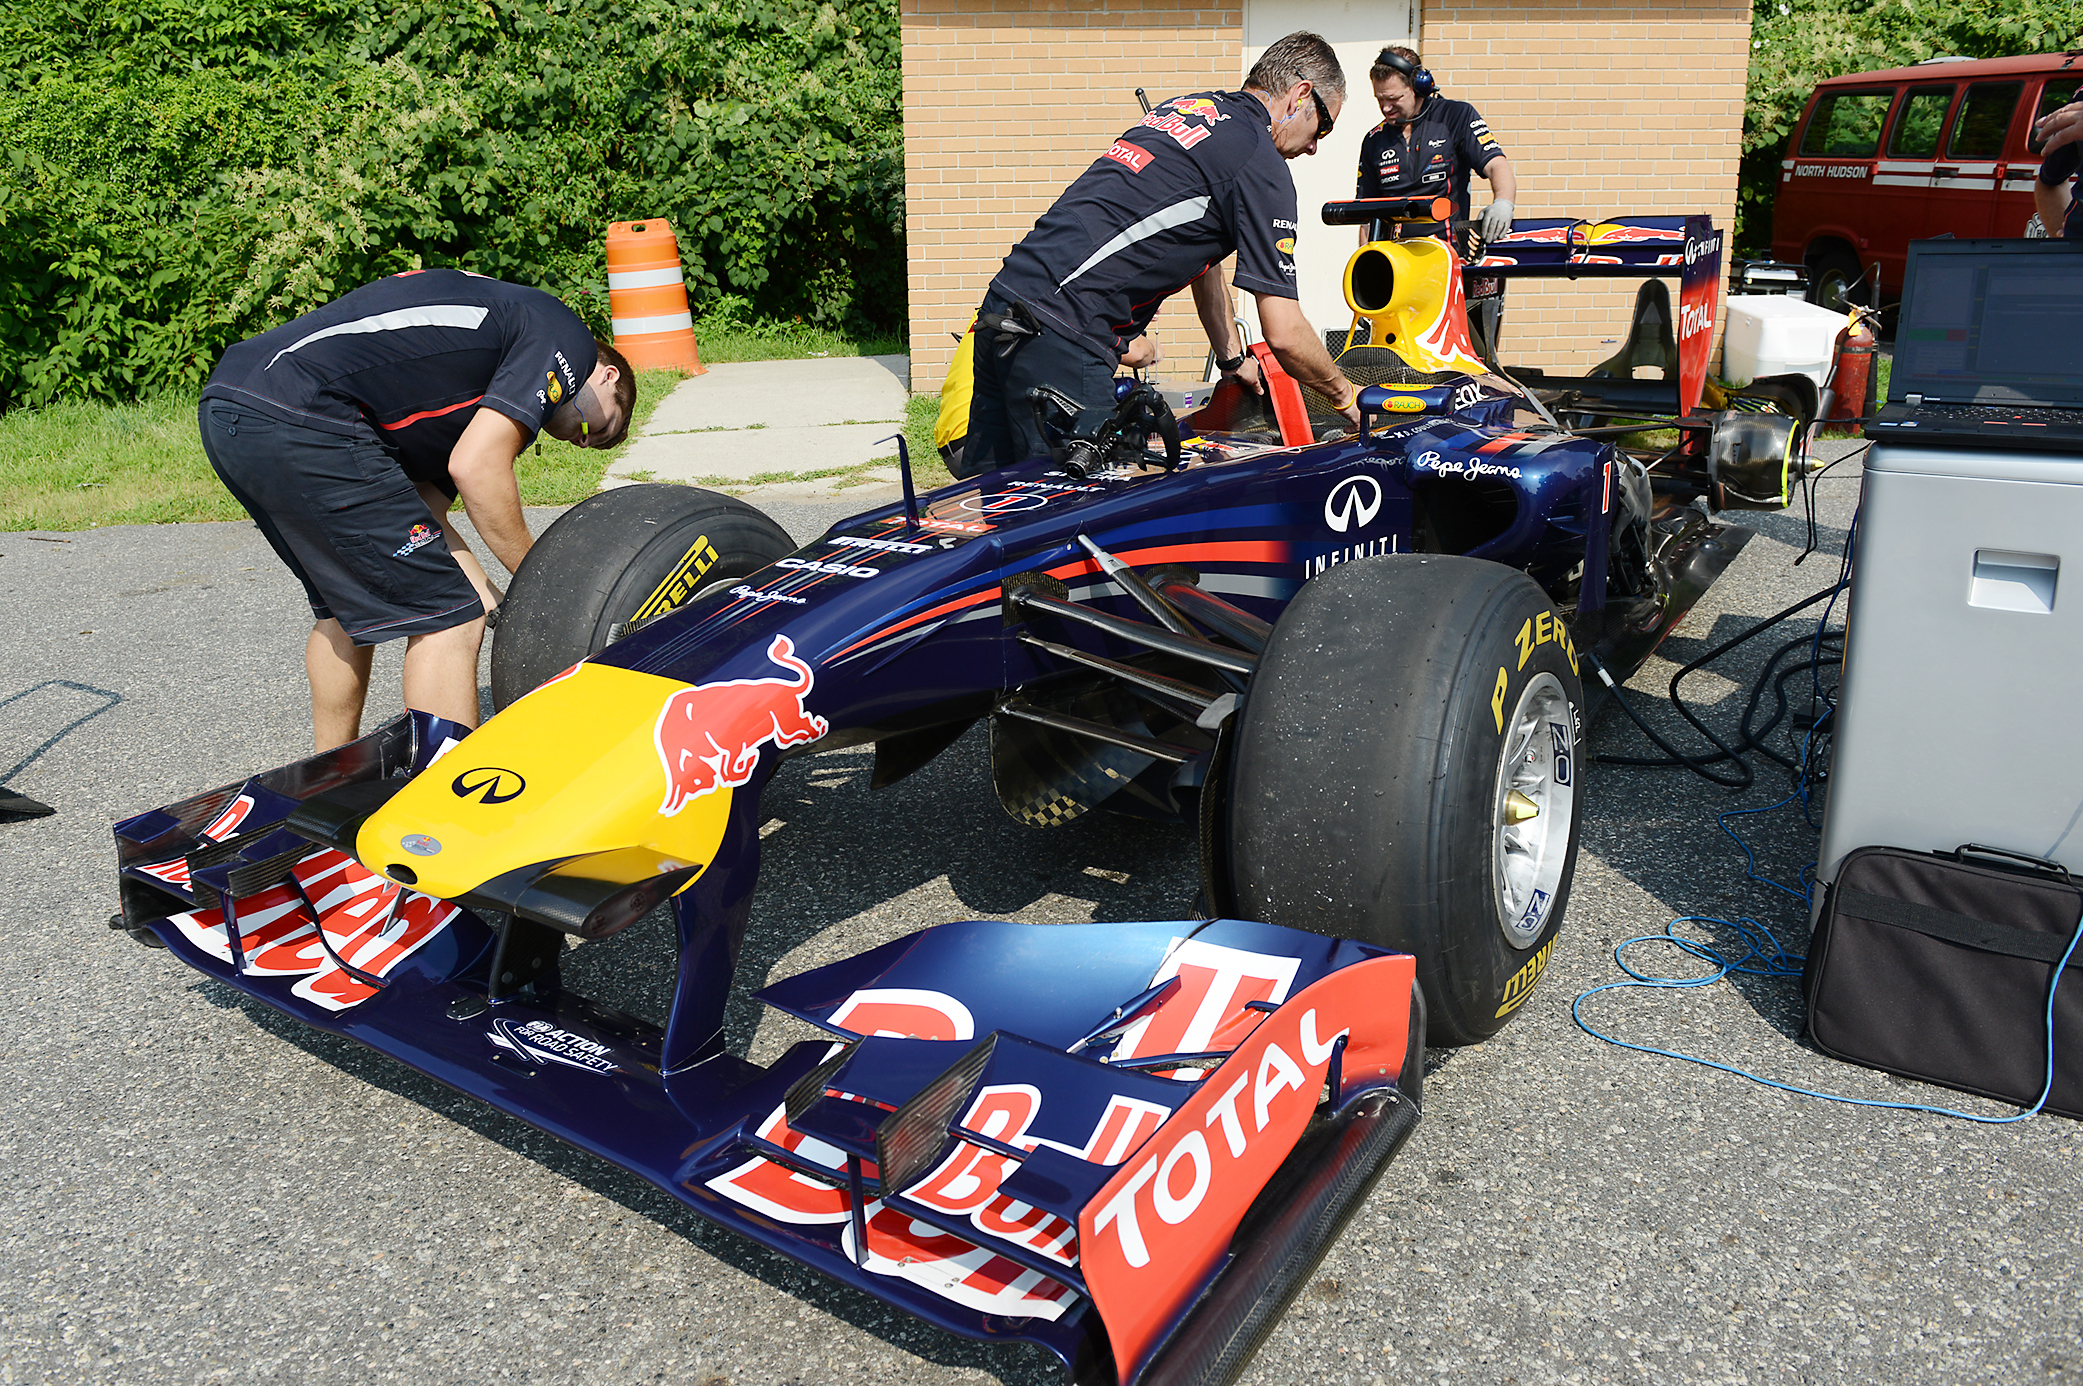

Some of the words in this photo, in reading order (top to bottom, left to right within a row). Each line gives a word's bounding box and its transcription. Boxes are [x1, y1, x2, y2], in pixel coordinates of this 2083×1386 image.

[1795, 165, 1826, 177] NORTH
[1826, 166, 1868, 178] HUDSON
[1681, 302, 1712, 340] TOTAL
[1394, 401, 1421, 409] RAUCH
[1417, 451, 1464, 478] Pepe
[1463, 457, 1523, 482] Jeans
[1007, 481, 1107, 492] RENAULT
[1602, 461, 1612, 515] 1
[827, 536, 934, 554] PIRELLI
[775, 558, 880, 578] CASIO
[729, 585, 765, 602] Pepe
[756, 591, 806, 604] Jeans
[1491, 666, 1508, 735] P
[513, 1026, 536, 1038] FOR
[528, 1032, 568, 1052] ROAD
[563, 1047, 619, 1071] SAFETY
[545, 1029, 613, 1056] ACTION
[1094, 1008, 1350, 1268] TOTAL
